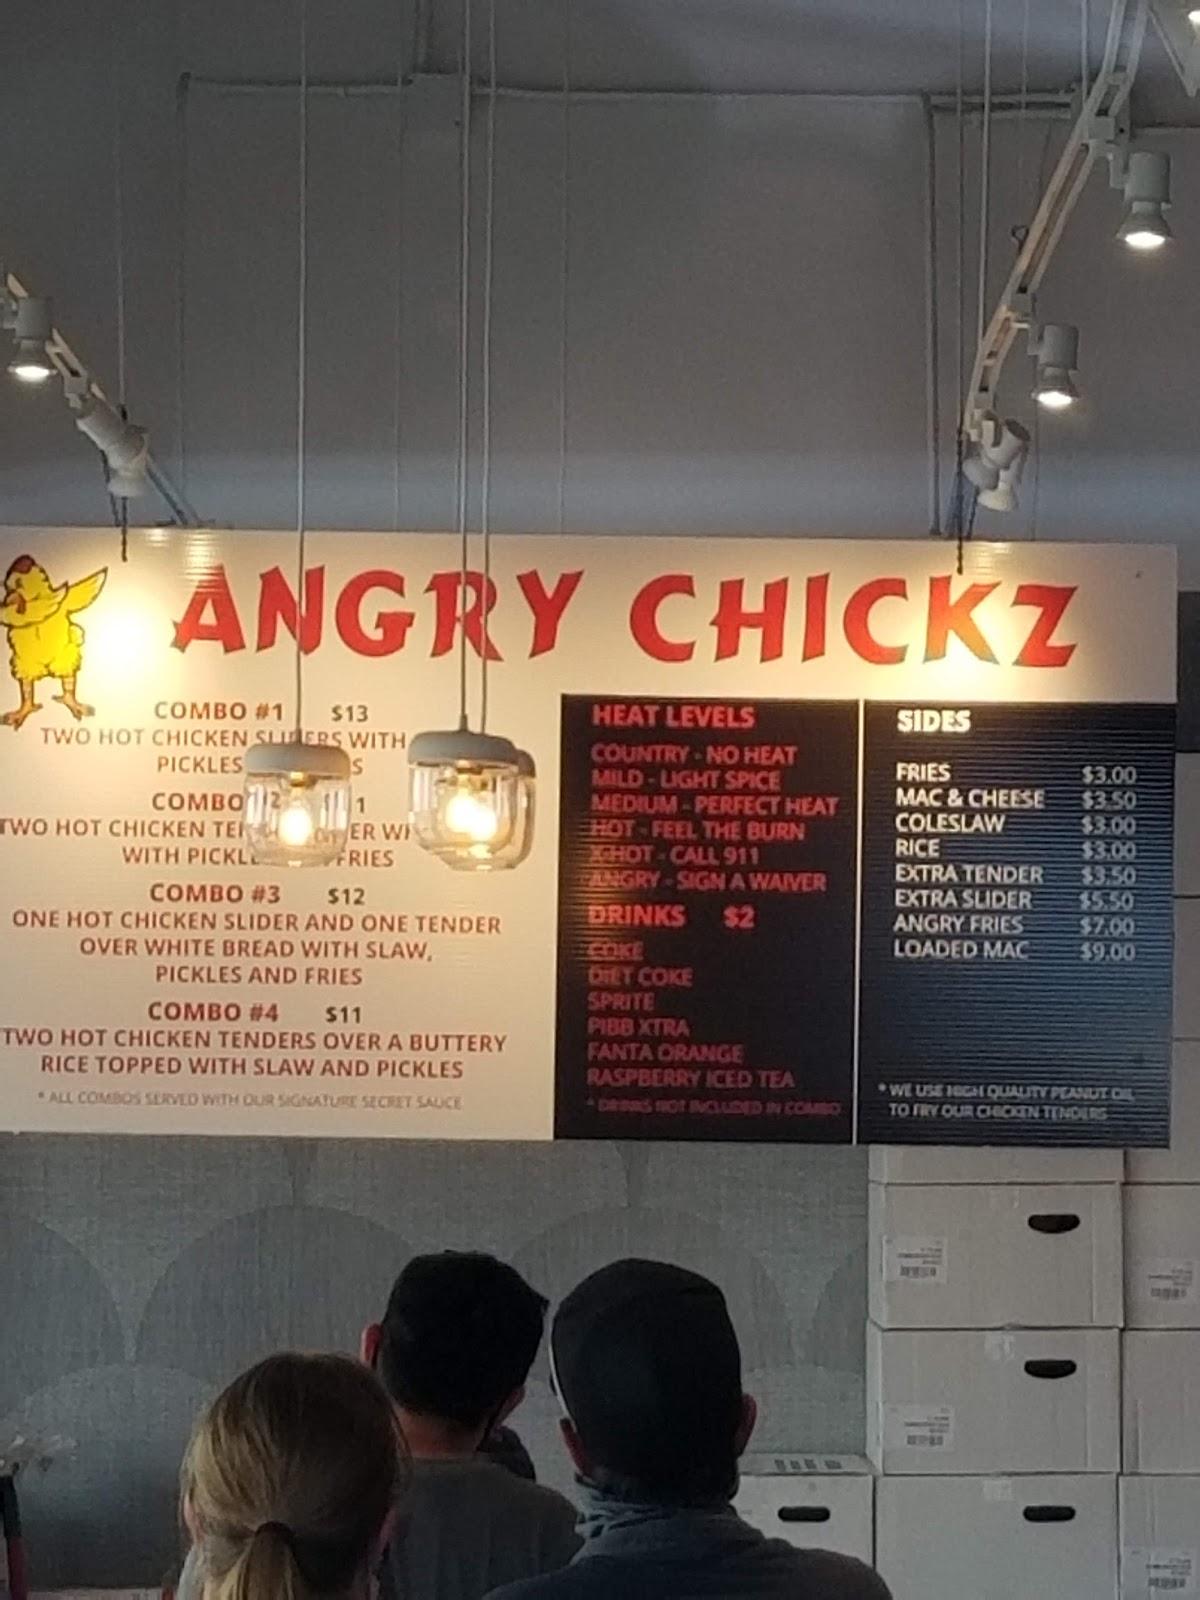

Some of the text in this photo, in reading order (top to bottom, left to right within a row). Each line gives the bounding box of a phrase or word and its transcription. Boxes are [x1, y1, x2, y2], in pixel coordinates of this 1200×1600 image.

[170, 564, 1079, 669] ANGRY CHICKZ
[154, 702, 369, 723] COMBO #1 $13
[592, 704, 755, 730] HEAT LEVELS
[896, 710, 972, 733] SIDES
[41, 727, 91, 745] TWO
[99, 728, 146, 746] HOT
[152, 729, 248, 748] CHICKEN
[349, 731, 407, 750] WITH
[157, 755, 243, 774] PICKLES
[591, 744, 690, 764] COUNTRY
[705, 745, 739, 765] NO
[744, 745, 798, 766] HEAT
[591, 769, 644, 789] MILD
[660, 770, 719, 790] LIGHT
[724, 771, 781, 791] SPICE
[895, 763, 1138, 785] FRIES $3.00
[152, 792, 244, 812] COMBO
[591, 794, 678, 814] MEDIUM
[694, 796, 780, 816] PERFECT
[784, 797, 839, 817] HEAT
[895, 788, 1138, 811] MAC & CHEESE $3.50
[0, 818, 48, 837] TWO
[56, 818, 102, 837] HOT
[109, 819, 205, 838] CHICKEN
[590, 819, 635, 839] HOT
[652, 820, 697, 840] FEEL
[702, 821, 741, 841] THE
[748, 822, 805, 842] BURN
[894, 813, 1137, 836] COLESLAW $3.00
[122, 846, 179, 865] WITH
[188, 847, 261, 867] PICKL
[669, 846, 720, 866] CALL
[723, 847, 759, 866] 911
[895, 838, 1137, 861] RICE $3.00
[588, 870, 661, 890] ANGRY
[676, 871, 725, 891] SIGN
[729, 872, 746, 891] A
[749, 872, 827, 893] WAIVER
[895, 863, 1137, 886] EXTRA TENDER $3.50
[149, 883, 366, 906] COMBO #3 $12
[894, 889, 1136, 911] EXTRA SLIDER $5.50
[12, 910, 501, 935] ONE HOT CHICKEN SLIDER AND ONE TENDER
[587, 904, 755, 929] DRINKS $2
[893, 913, 1136, 936] ANGRY FRIES $7.00
[79, 938, 434, 963] OVER WHITE BREAD WITH SLAW,
[588, 941, 644, 961] COKE
[893, 938, 1137, 962] LOADED MAC $9.00
[156, 965, 363, 986] PICKLES AND FRIES
[587, 966, 693, 987] DIET COKE
[148, 1001, 363, 1025] COMBO #4 $11
[587, 992, 656, 1012] SPRITE
[587, 1017, 691, 1037] PIBB XTRA
[2, 1028, 508, 1053] TWO HOT CHICKEN TENDERS OVER A BUTTERY
[587, 1042, 744, 1064] FANTA ORANGE
[41, 1055, 464, 1079] RICE TOPPED WITH SLAW AND PICKLES
[587, 1067, 796, 1089] RASPBERRY ICED TEA
[50, 1091, 463, 1110] ALL COMBOS SERVED WITH OUR SIGNATURE SECRET SAUCE
